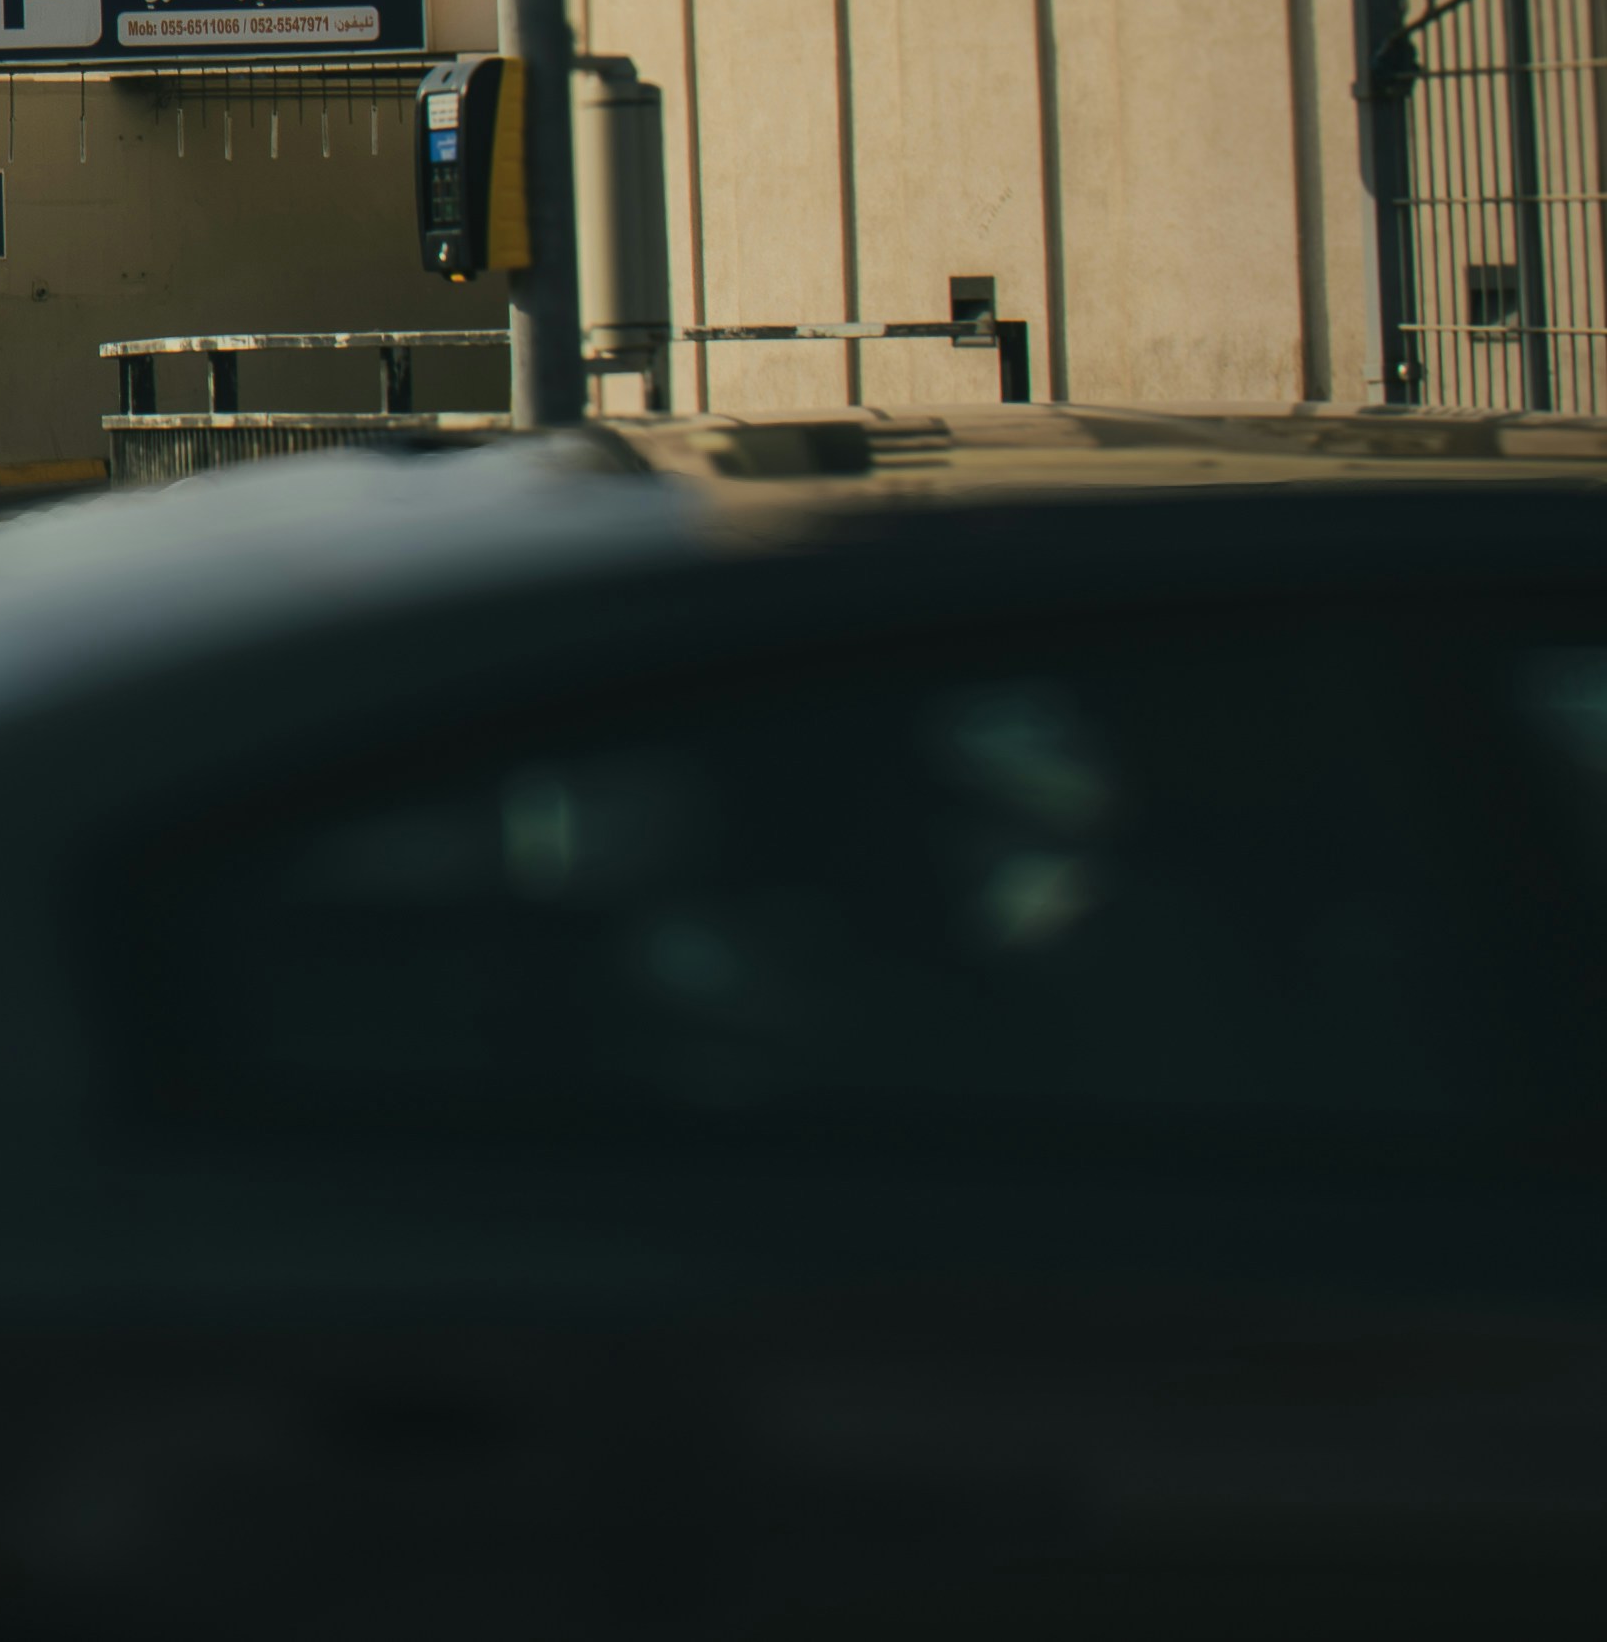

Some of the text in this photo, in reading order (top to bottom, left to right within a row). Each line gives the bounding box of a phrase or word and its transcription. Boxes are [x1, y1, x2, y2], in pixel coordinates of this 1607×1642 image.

[128, 19, 157, 37] Mob:
[161, 17, 240, 36] 055-6511066
[250, 15, 330, 34] 052-5547971
